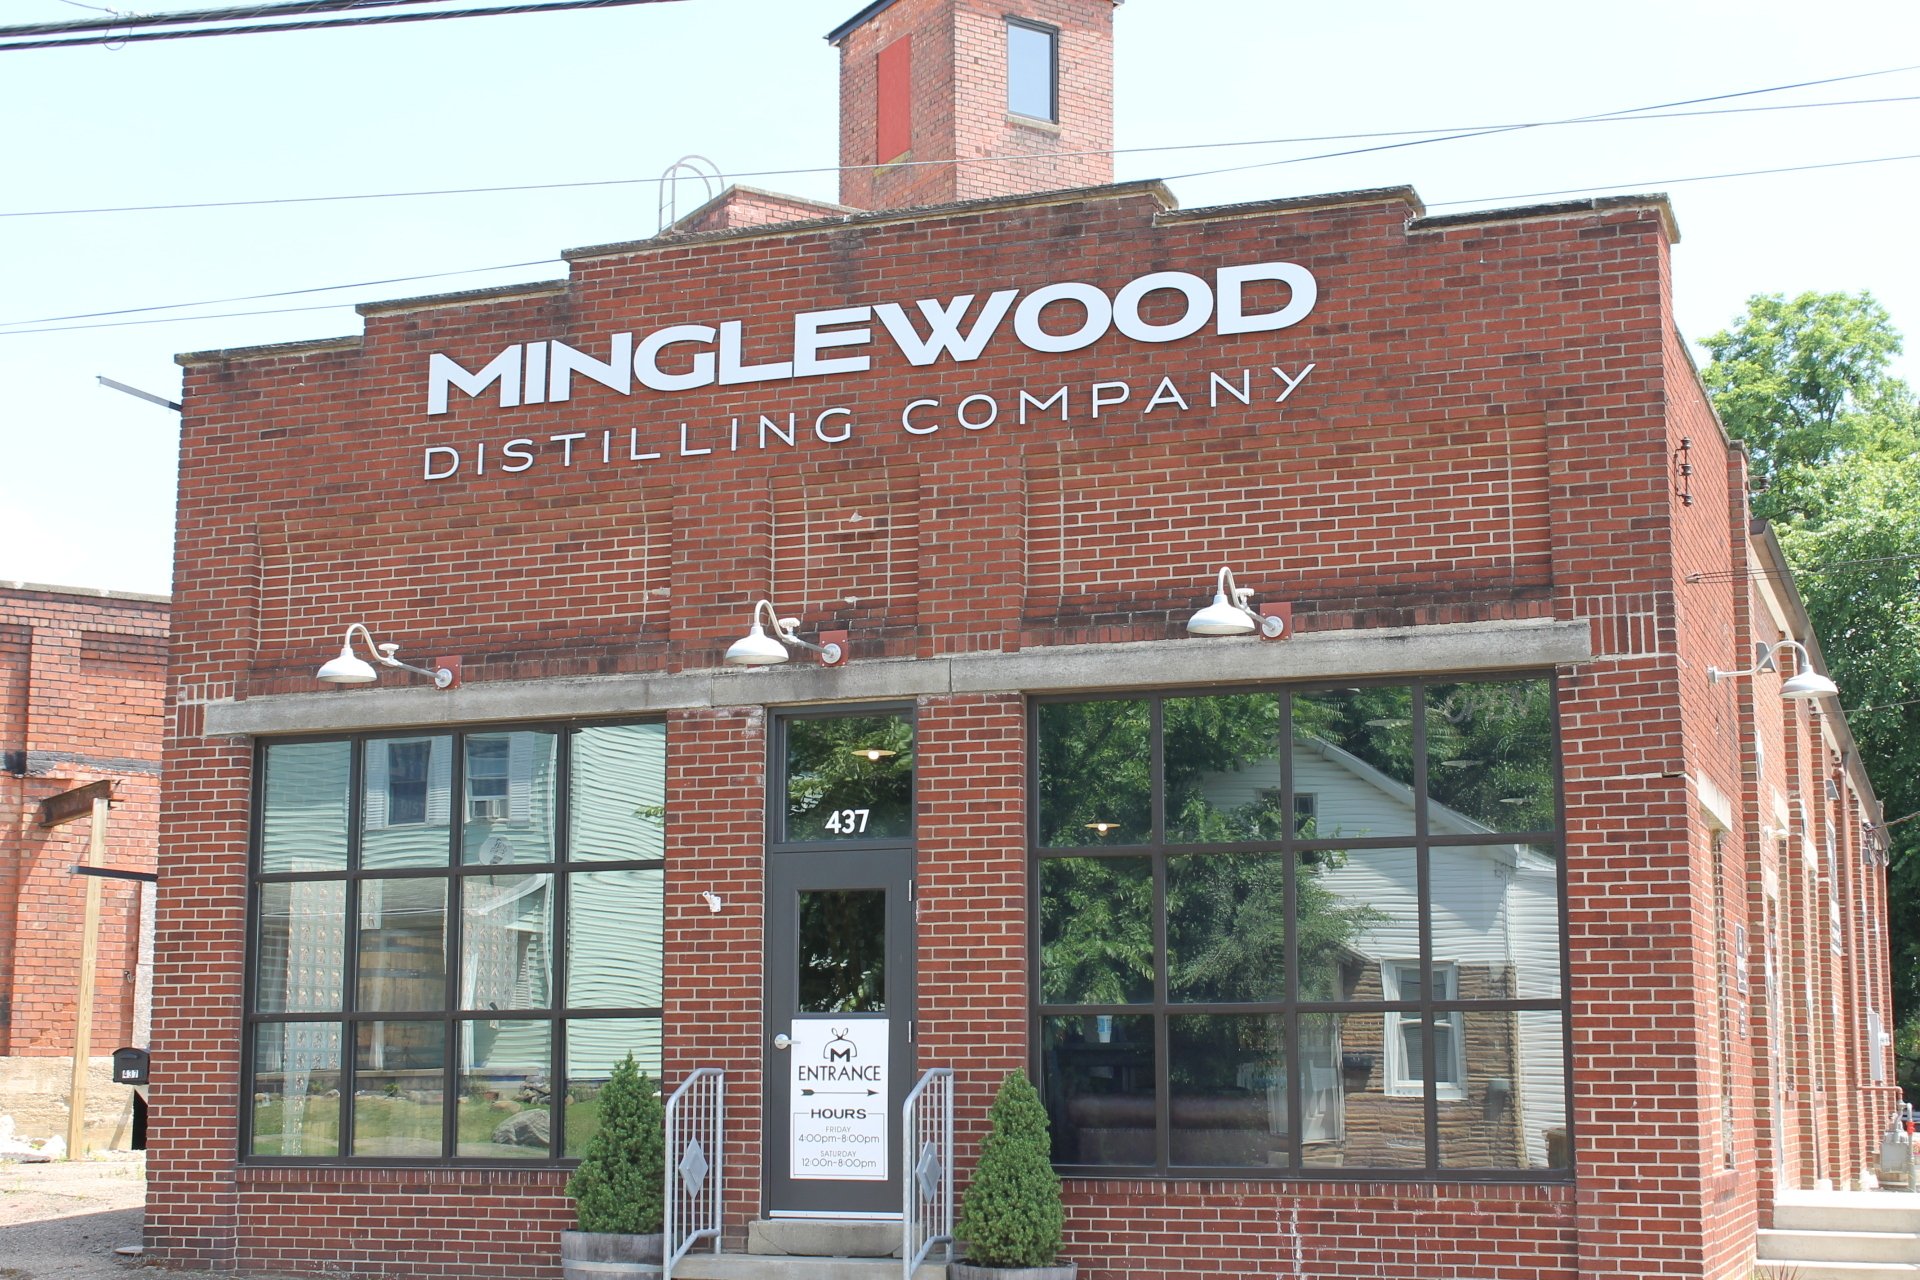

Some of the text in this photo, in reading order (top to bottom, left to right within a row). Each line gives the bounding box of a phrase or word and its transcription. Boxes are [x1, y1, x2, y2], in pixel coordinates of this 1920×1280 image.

[427, 261, 1318, 416] MINGLEWOOD
[424, 363, 1316, 481] DISTILLING COMPANY
[824, 808, 870, 834] 437
[830, 1048, 850, 1062] M
[122, 1070, 139, 1078] 437
[798, 1065, 881, 1081] ENTRANCE
[810, 1108, 867, 1120] HOURS
